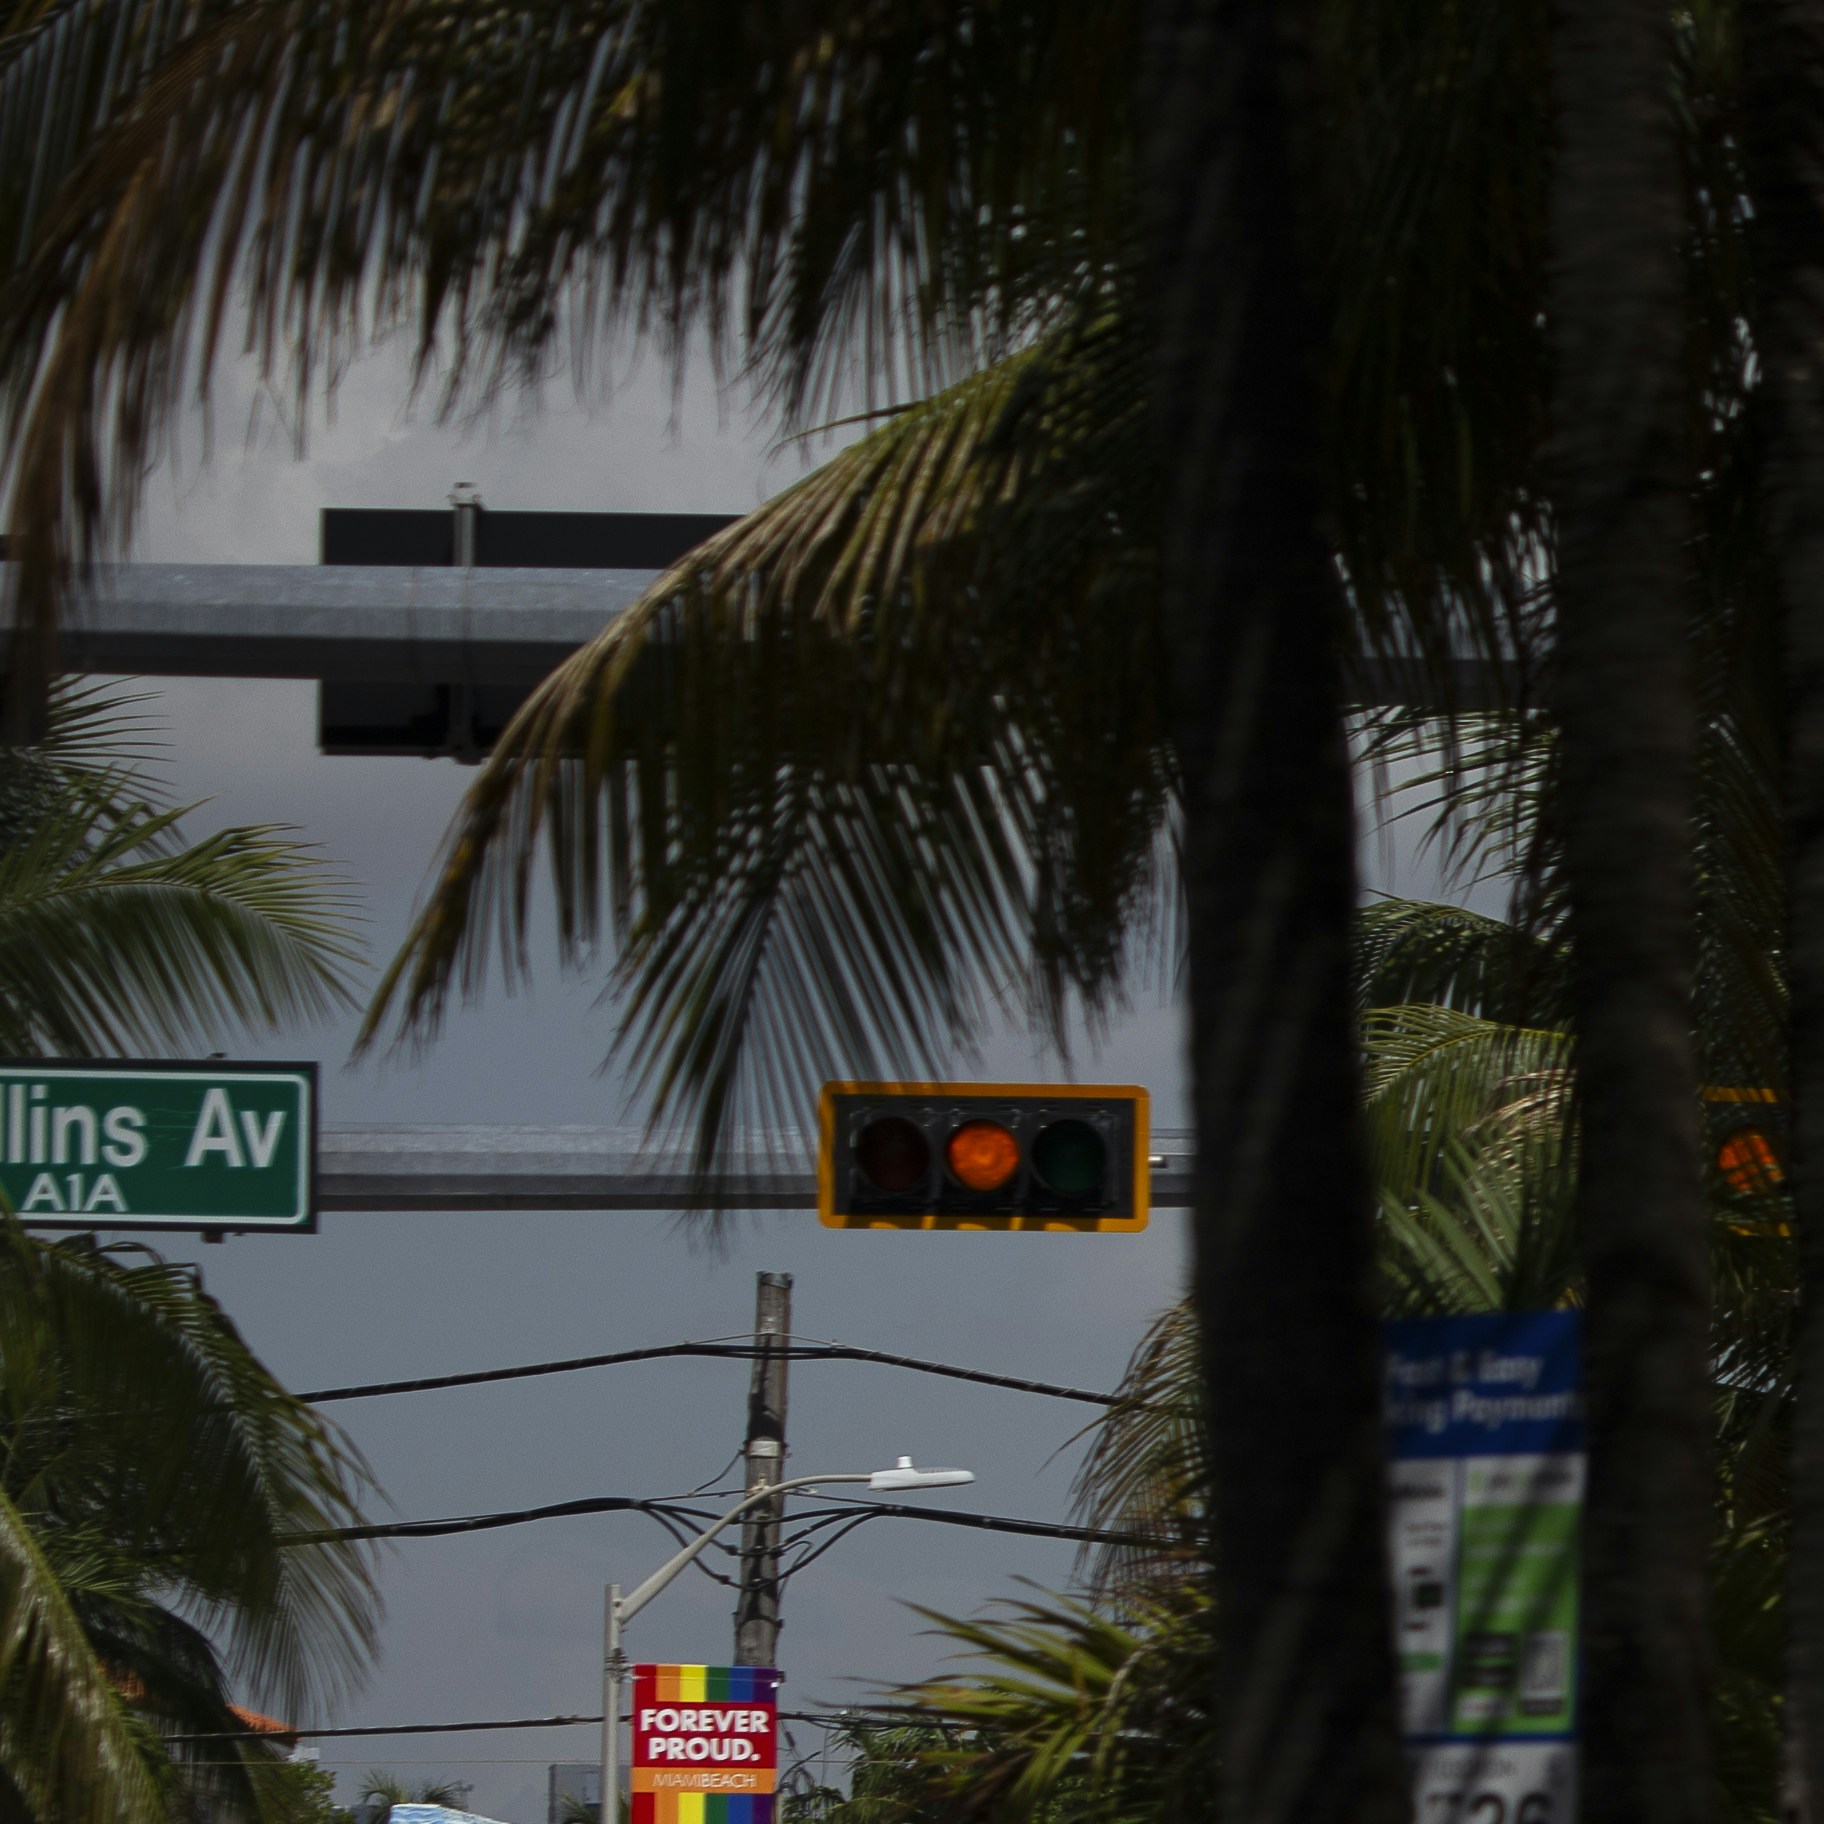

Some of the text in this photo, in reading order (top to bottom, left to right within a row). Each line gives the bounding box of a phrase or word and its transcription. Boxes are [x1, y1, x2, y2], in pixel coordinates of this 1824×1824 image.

[183, 1087, 287, 1168] Av
[20, 1172, 129, 1212] A1A
[640, 1708, 770, 1733] FOREVER
[648, 1736, 761, 1762] PROUD.
